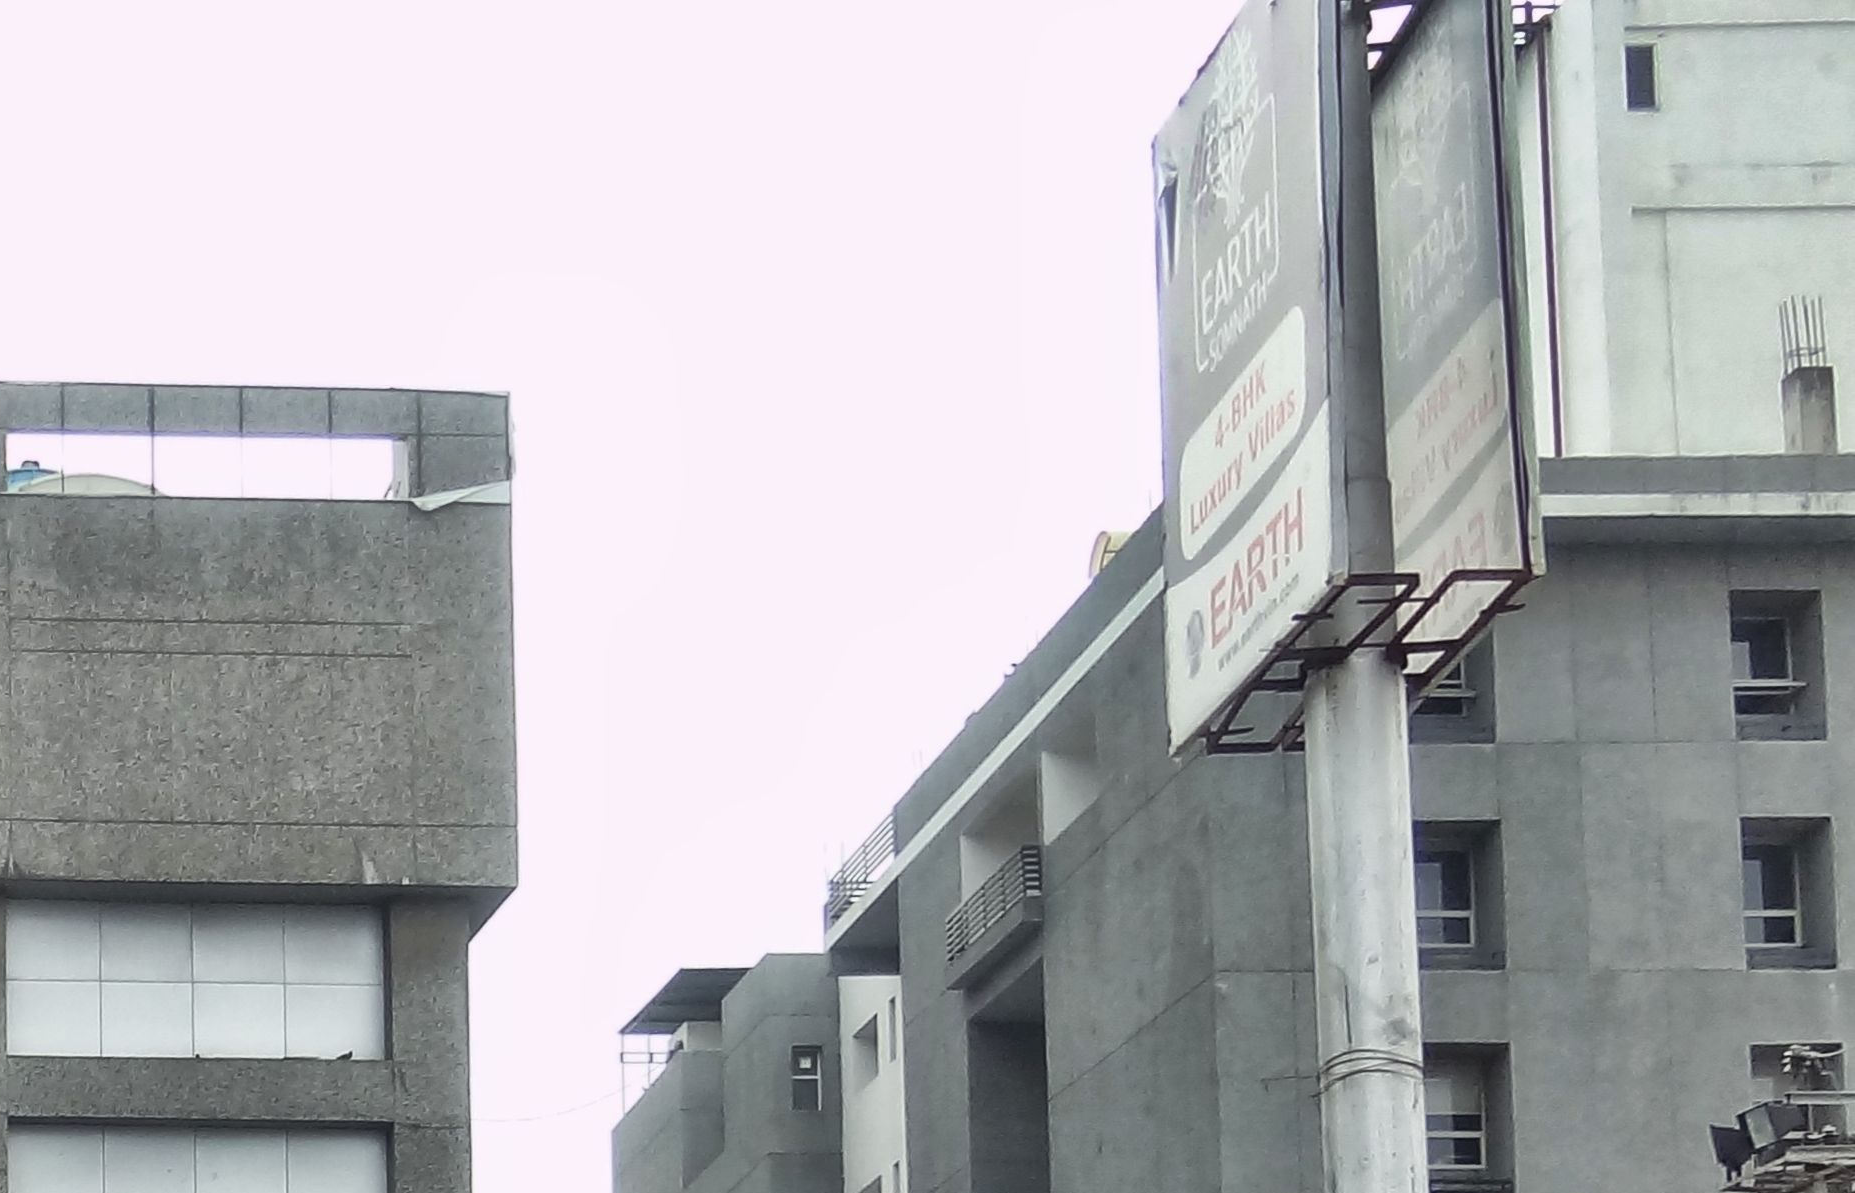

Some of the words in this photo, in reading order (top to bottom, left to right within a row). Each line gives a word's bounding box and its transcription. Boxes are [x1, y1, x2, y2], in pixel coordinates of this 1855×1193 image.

[1200, 191, 1272, 331] EARTH
[1209, 277, 1268, 373] SOMNATH
[1189, 450, 1244, 536] Luxury
[1248, 388, 1297, 465] Villas
[1214, 359, 1268, 449] 4-BHK
[1209, 487, 1304, 649] EARTH
